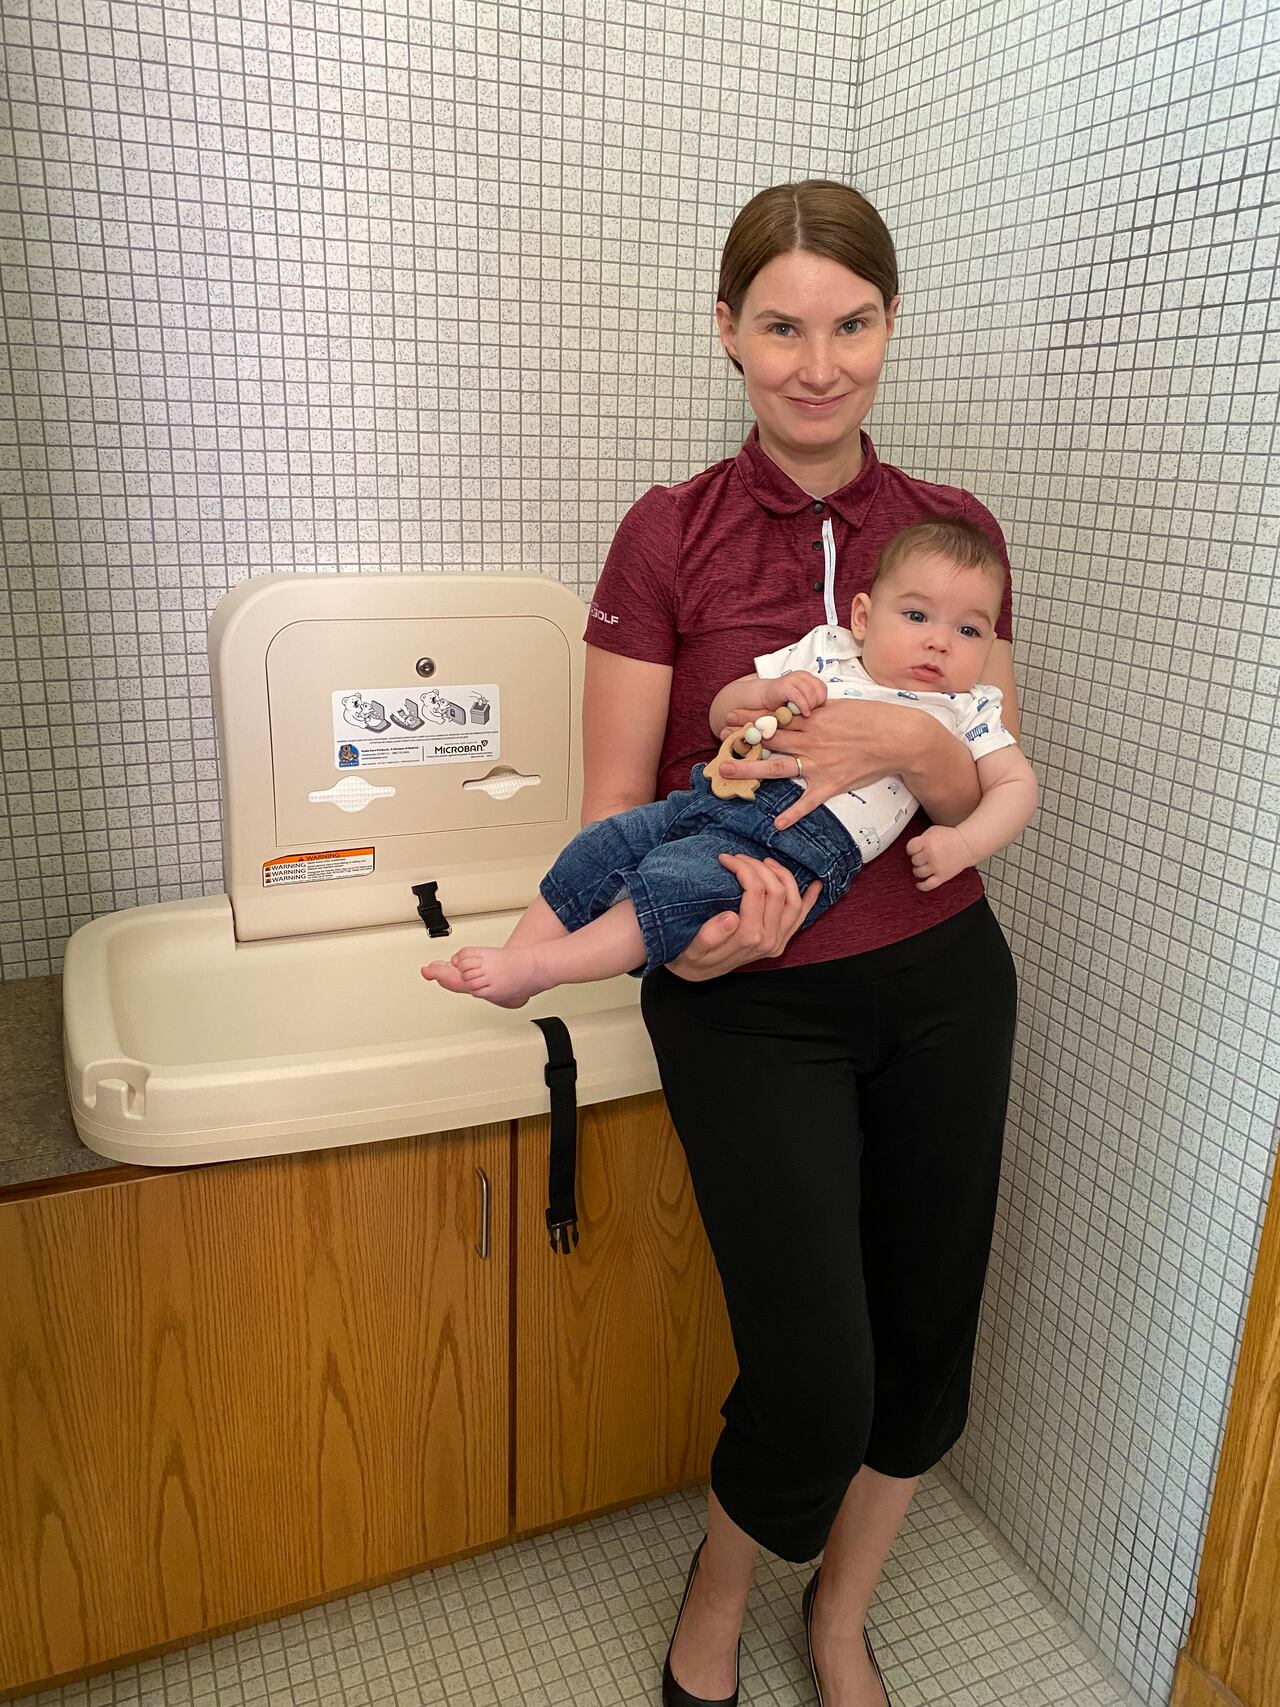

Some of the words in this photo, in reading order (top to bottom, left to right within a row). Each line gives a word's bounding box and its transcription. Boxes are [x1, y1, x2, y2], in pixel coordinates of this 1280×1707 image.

[434, 744, 483, 754] MICROBAN
[306, 853, 340, 861] WARNING
[271, 862, 306, 871] WARNING
[271, 868, 307, 877] WARNING
[271, 874, 307, 883] WARNING
